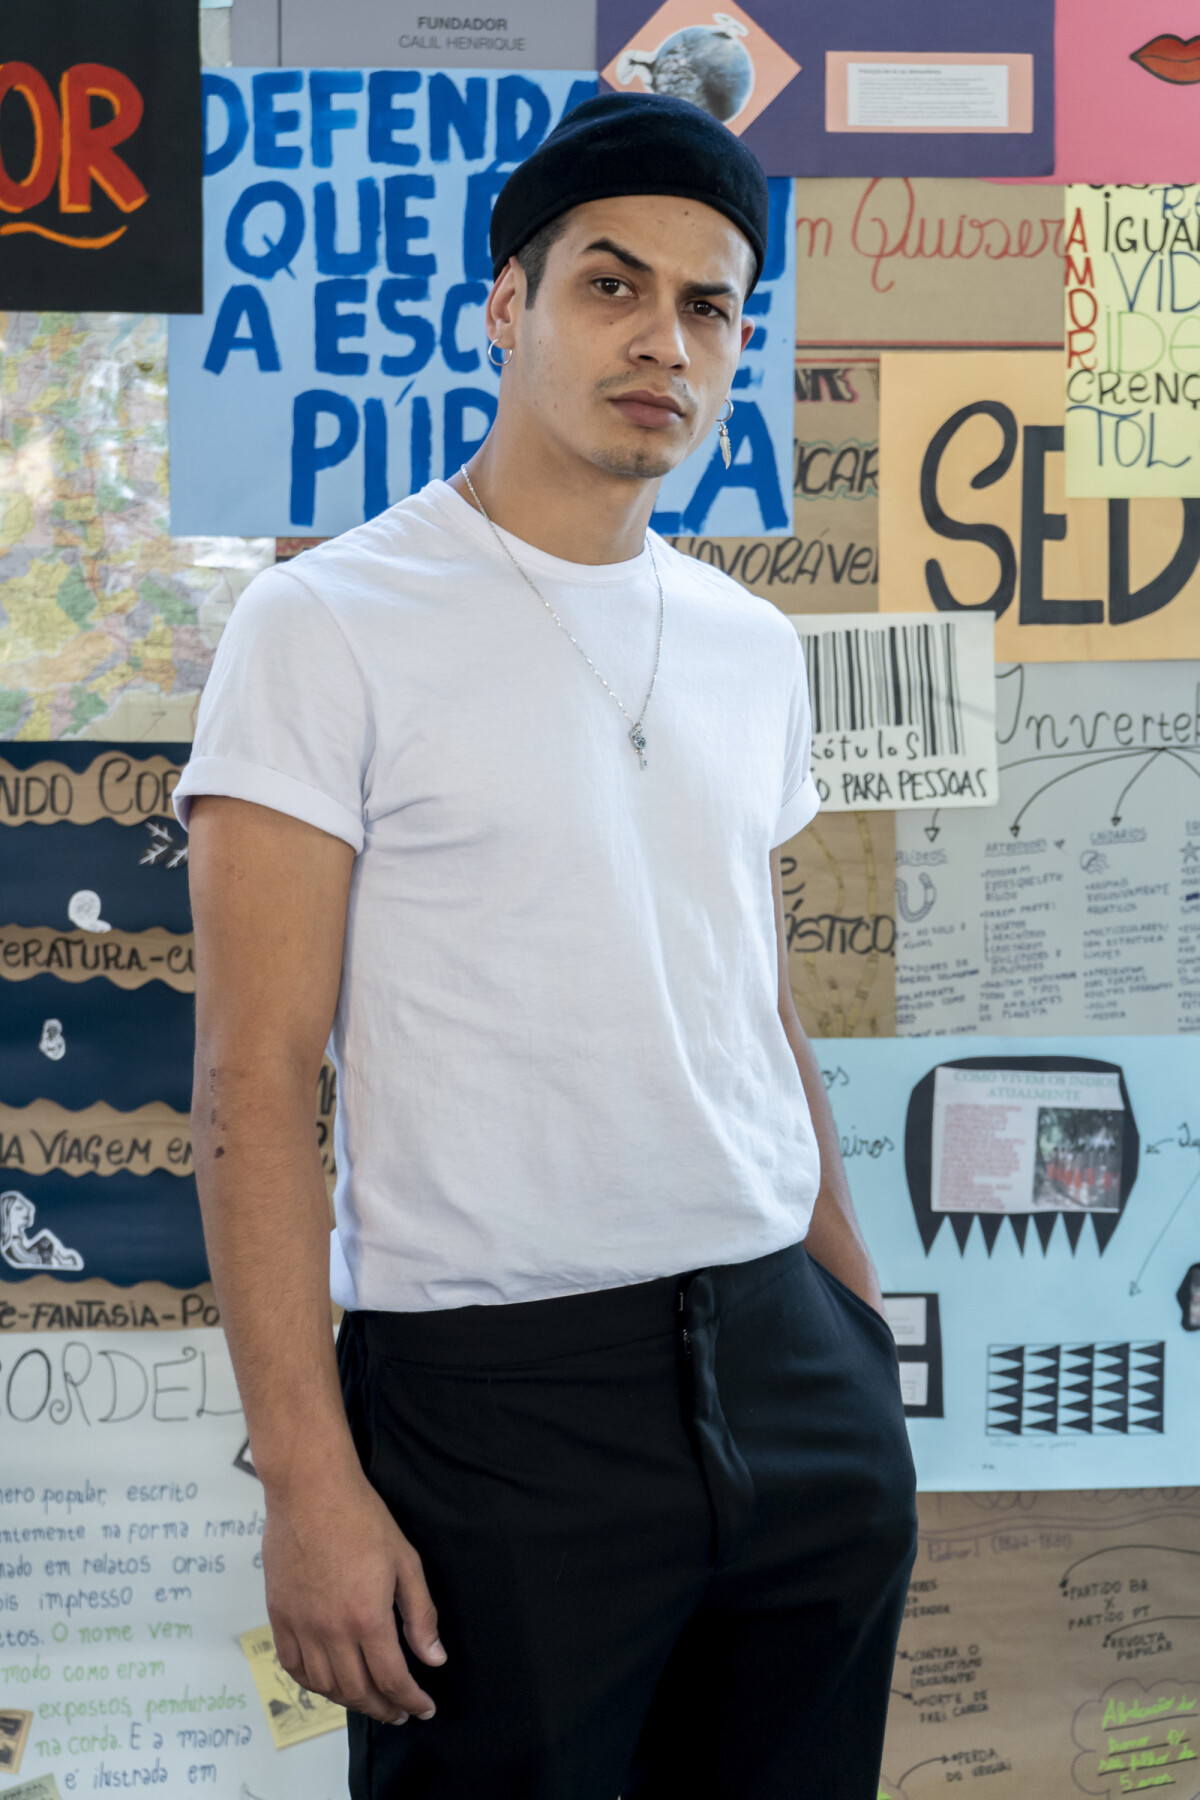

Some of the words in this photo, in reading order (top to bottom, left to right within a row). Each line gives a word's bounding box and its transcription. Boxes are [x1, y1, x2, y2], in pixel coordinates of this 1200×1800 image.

[416, 16, 508, 31] FUNDADOR
[398, 35, 443, 49] CALIL
[446, 36, 526, 51] HENRIQUE
[225, 173, 438, 280] QUE
[203, 284, 282, 376] A
[995, 664, 1200, 750] Inverte
[842, 772, 893, 805] PARA
[898, 767, 987, 801] PESSOAS
[0, 1341, 243, 1425] ORDEL
[126, 1482, 198, 1503] escrito
[102, 1523, 121, 1540] na
[128, 1521, 189, 1544] forma
[45, 1560, 71, 1578] em
[83, 1552, 151, 1577] relatos
[172, 1554, 226, 1576] orais
[39, 1585, 133, 1618] impresso
[154, 1585, 192, 1604] em
[52, 1621, 69, 1643] O
[77, 1625, 134, 1645] nome
[117, 1660, 166, 1681] eram
[145, 1683, 248, 1723] pendurados
[35, 1737, 62, 1758] na
[130, 1722, 142, 1751] E
[153, 1732, 164, 1750] a
[176, 1724, 252, 1750] maioria
[93, 1756, 169, 1790] ilustrada
[188, 1763, 217, 1785] em
